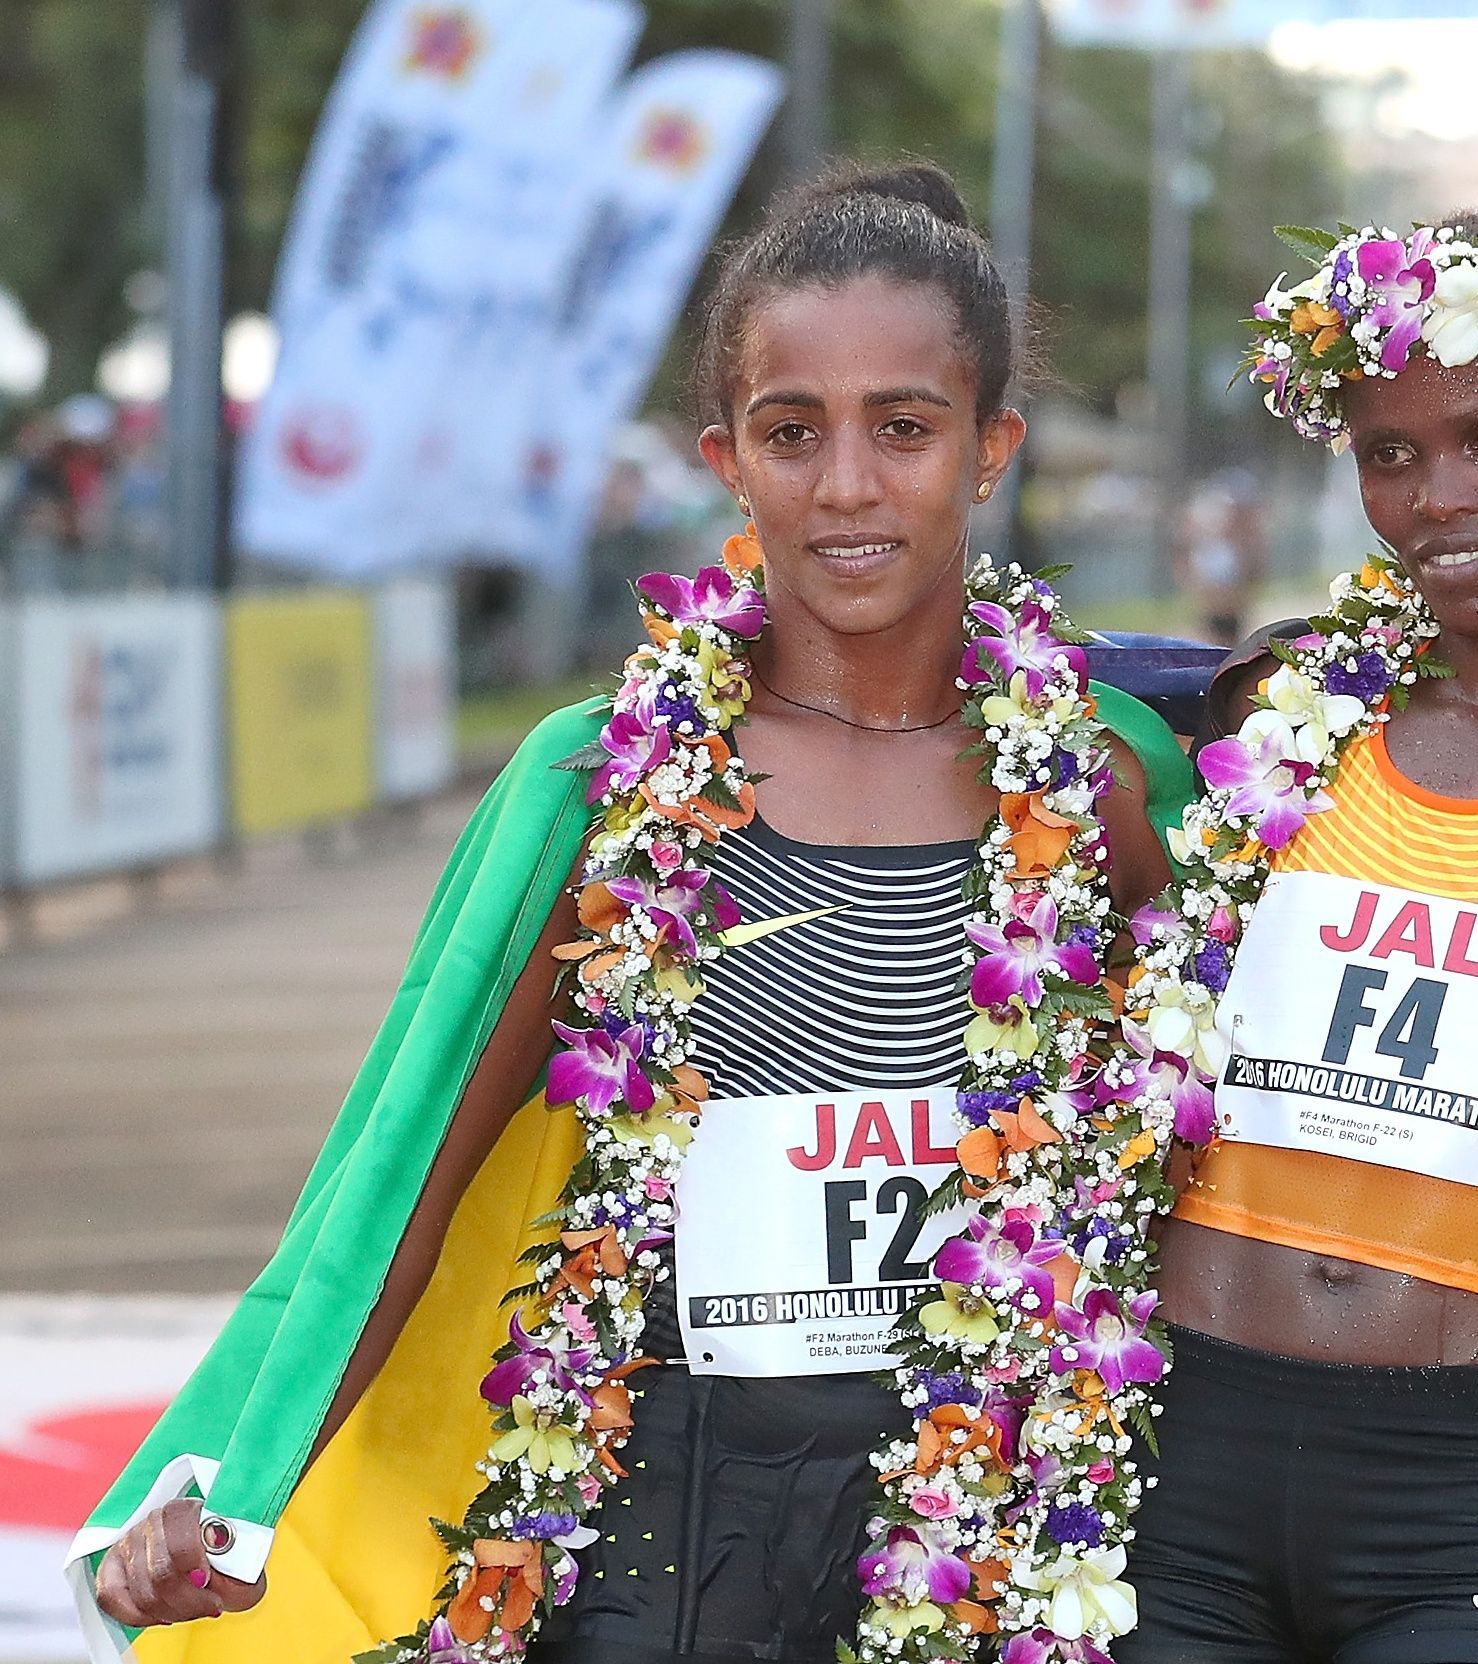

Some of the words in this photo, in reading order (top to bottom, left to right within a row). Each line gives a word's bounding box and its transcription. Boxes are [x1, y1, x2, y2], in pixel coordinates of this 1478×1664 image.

[1321, 963, 1449, 1080] F4
[1268, 1062, 1390, 1106] HONOLULU
[786, 1100, 961, 1171] JAL
[1299, 1111, 1318, 1121] #F4
[1320, 1113, 1370, 1131] Marathon
[1373, 1123, 1397, 1136] F-22
[1398, 1129, 1414, 1141] (S)
[1299, 1124, 1335, 1139] KOSEI,
[1338, 1130, 1378, 1146] BRIGID
[824, 1176, 930, 1284] F2
[705, 1297, 767, 1325] 2016
[775, 1289, 898, 1321] HONOLULU
[806, 1333, 824, 1343] #F2
[827, 1331, 875, 1343] Marathon
[809, 1346, 842, 1357] DEBA,
[845, 1344, 888, 1355] BUZUNE
